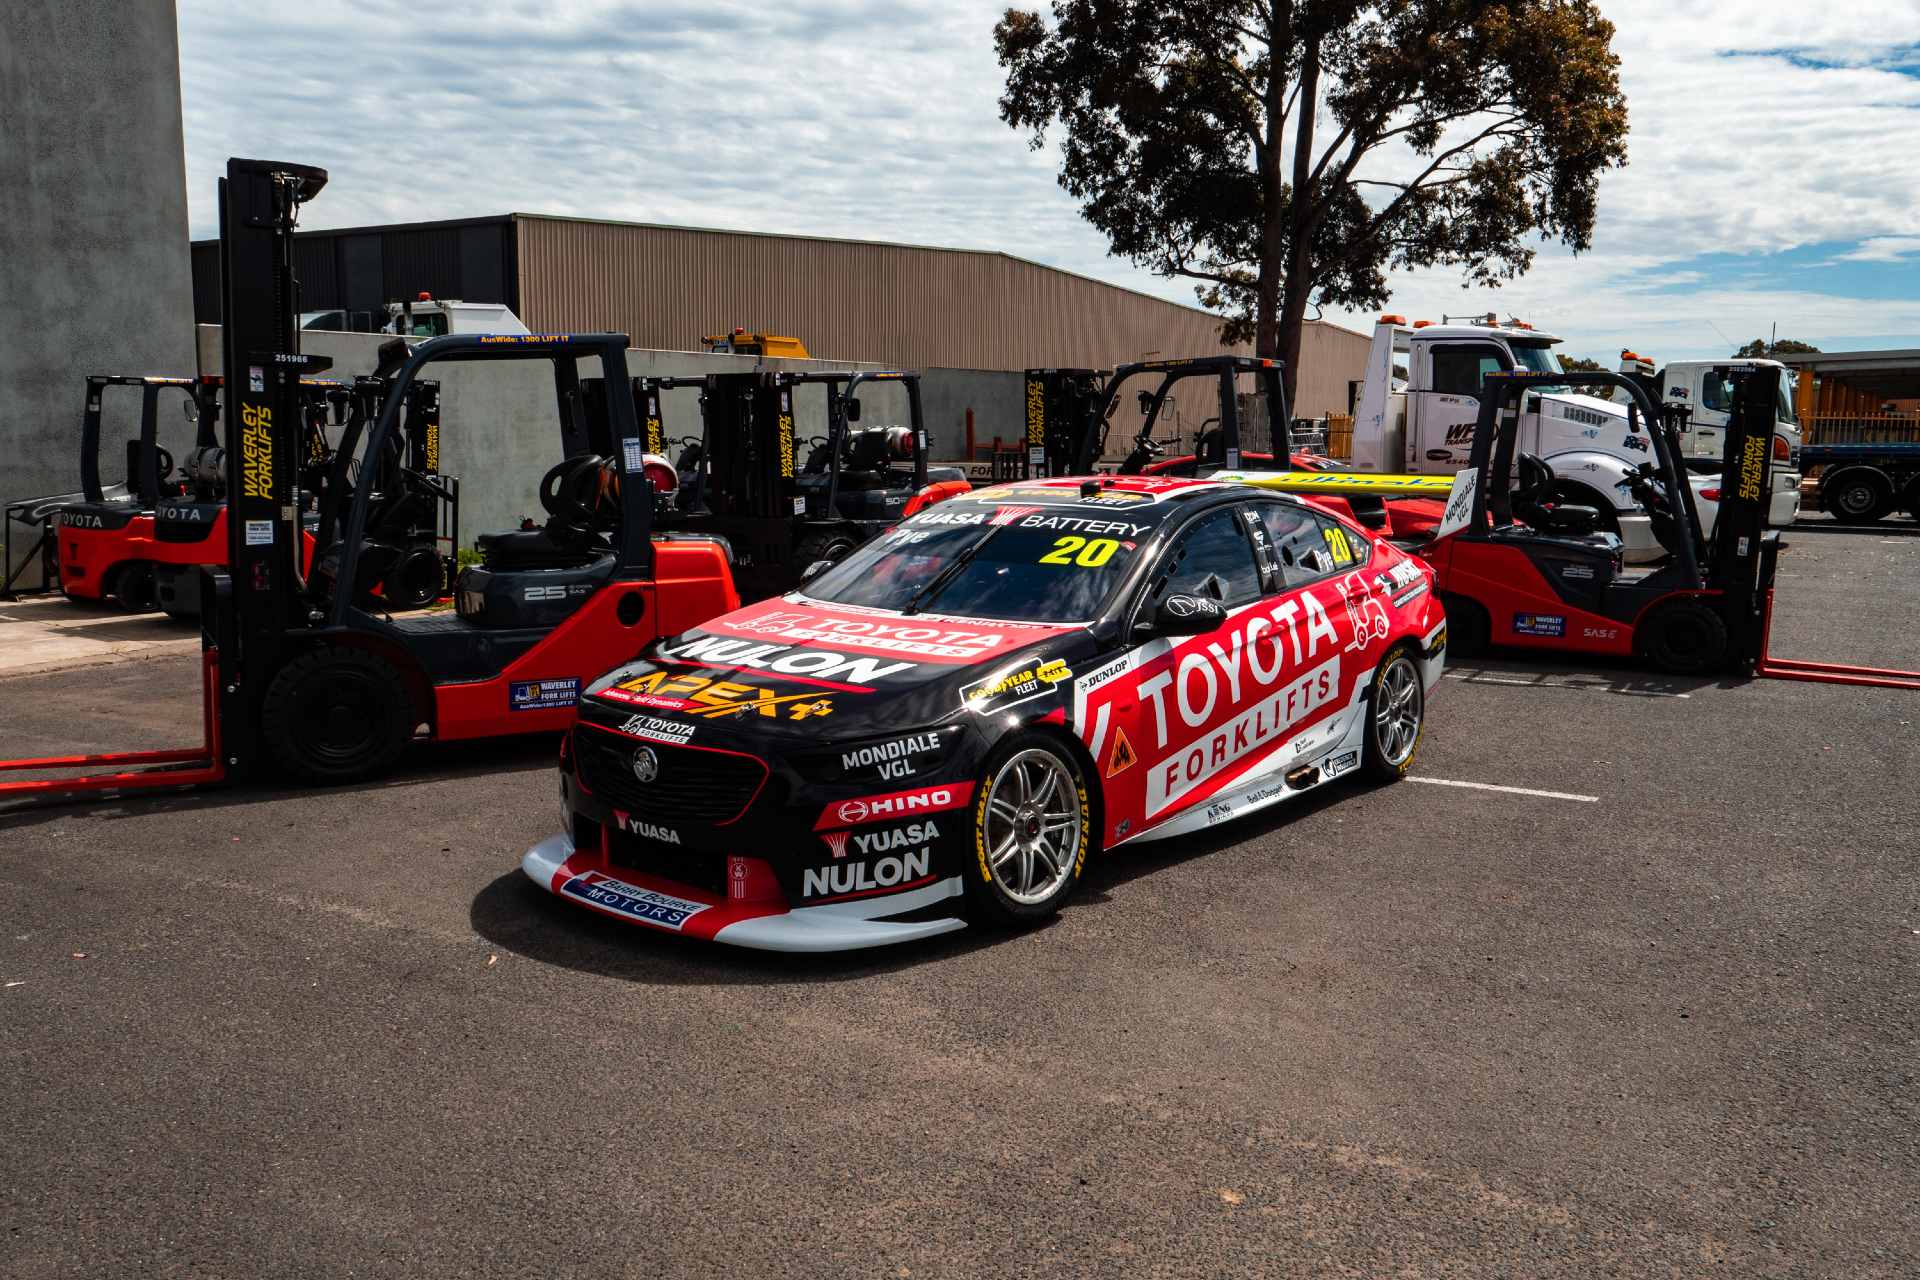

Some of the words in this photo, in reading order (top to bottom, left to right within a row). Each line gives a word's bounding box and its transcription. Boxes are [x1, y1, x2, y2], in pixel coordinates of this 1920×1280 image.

[1028, 380, 1036, 444] WAVERLEY
[1035, 381, 1044, 445] FORKLIFTS
[242, 402, 258, 496] WAVERLEY
[257, 405, 273, 499] FORKLIFTS
[779, 414, 789, 477] WAVERLEY
[784, 416, 794, 478] FORKLIFTS
[1739, 435, 1755, 499] FORKLIFTS
[1750, 437, 1766, 501] WAVERLEY
[1445, 475, 1476, 523] MONDIALE
[1457, 502, 1469, 522] VGL
[63, 512, 102, 527] OYOTA
[907, 512, 984, 525] YUASA
[1020, 515, 1151, 537] BATTERY
[886, 529, 930, 545] Pye
[1038, 536, 1120, 567] 20
[1324, 528, 1351, 562] 20
[1314, 550, 1333, 571] Pye
[1562, 567, 1594, 579] 25
[524, 585, 567, 601] 25
[811, 619, 1003, 648] TOYOTA
[663, 636, 918, 684] NULON
[1088, 659, 1128, 688] DUNLOP
[1136, 590, 1339, 750] TOYOTA
[541, 680, 576, 690] WAVERLEY
[1016, 680, 1039, 696] FLEET
[641, 728, 686, 743] FORKLIFTS
[645, 718, 696, 736] TOYOTA
[1165, 670, 1332, 798] FORKLIFTS
[842, 732, 941, 770] MONDIALE
[878, 759, 916, 781] VGL
[872, 790, 951, 814] HINO
[976, 775, 993, 827] MAXX
[630, 819, 681, 845] YUASA
[853, 821, 940, 854] YUASA
[1074, 787, 1089, 879] DUNLOP
[803, 847, 930, 897] NULON
[976, 829, 992, 882] SPORT
[587, 887, 684, 922] MOTORS
